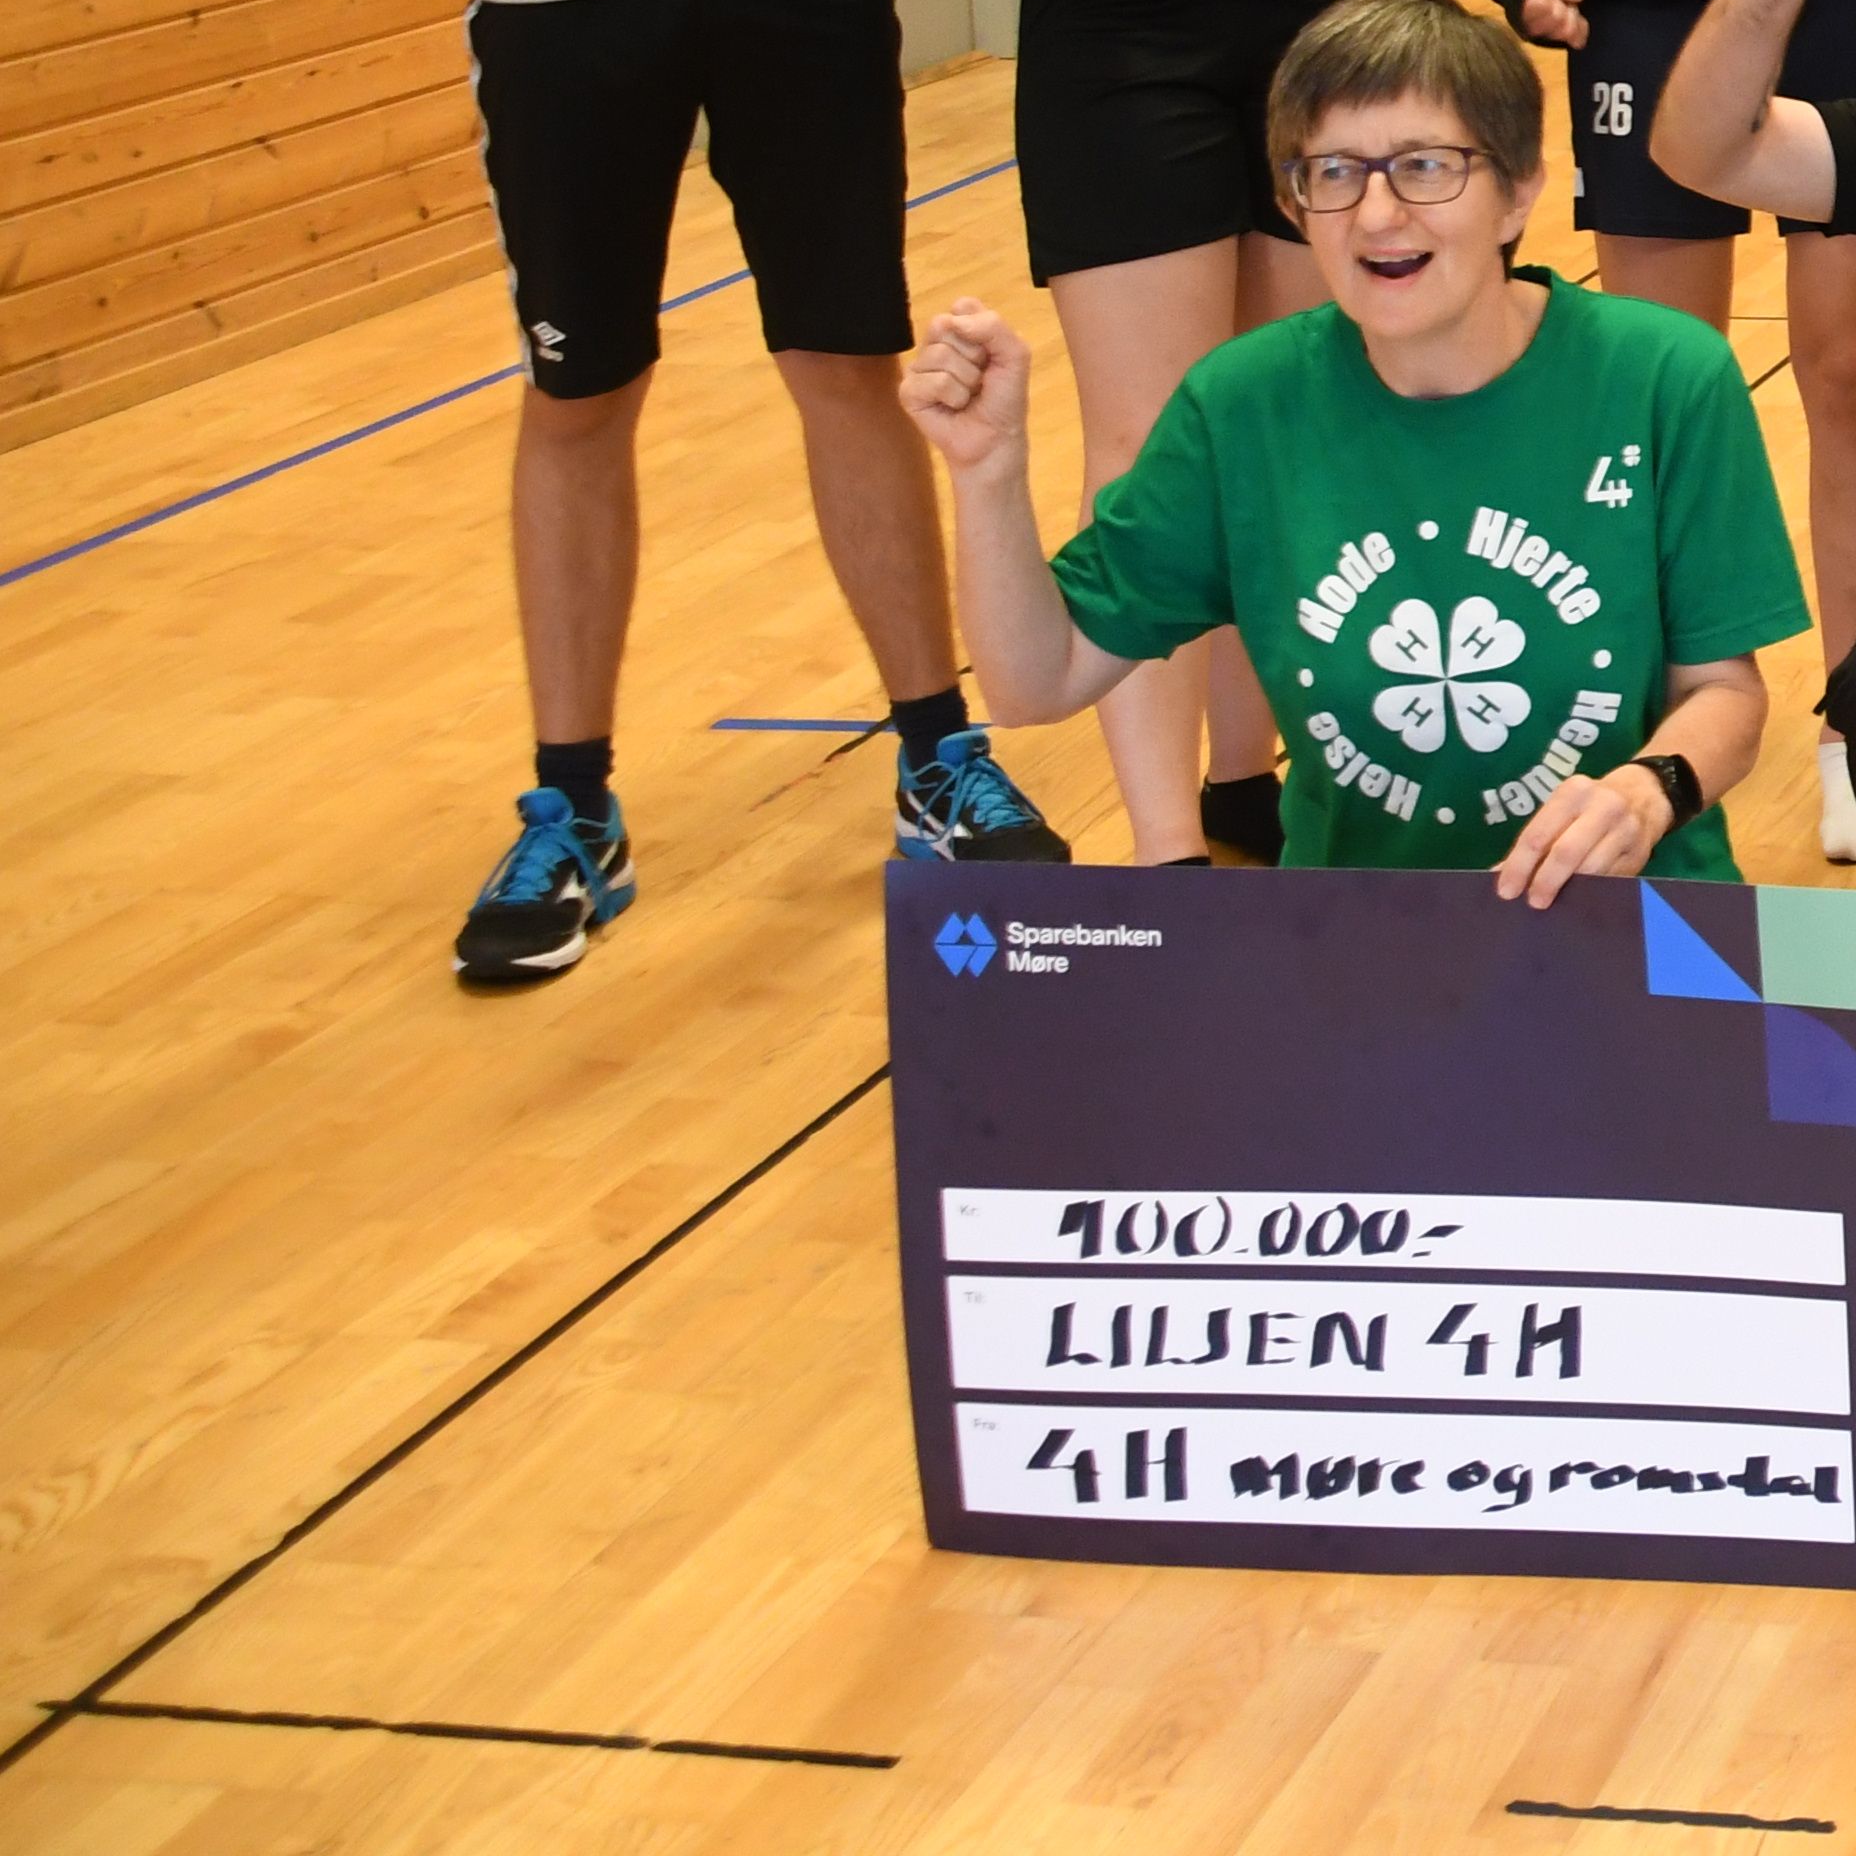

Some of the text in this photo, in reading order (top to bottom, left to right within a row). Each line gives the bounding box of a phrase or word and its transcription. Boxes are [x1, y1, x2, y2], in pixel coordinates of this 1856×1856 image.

[1591, 81, 1634, 137] 26
[1297, 531, 1397, 644] Hode
[1465, 506, 1602, 625] Hjerte
[1306, 710, 1423, 822] Helse
[1006, 921, 1162, 950] Sparebanken
[1006, 950, 1070, 975] Møre
[1427, 1302, 1583, 1379] 4H
[1026, 1427, 1189, 1504] 4H
